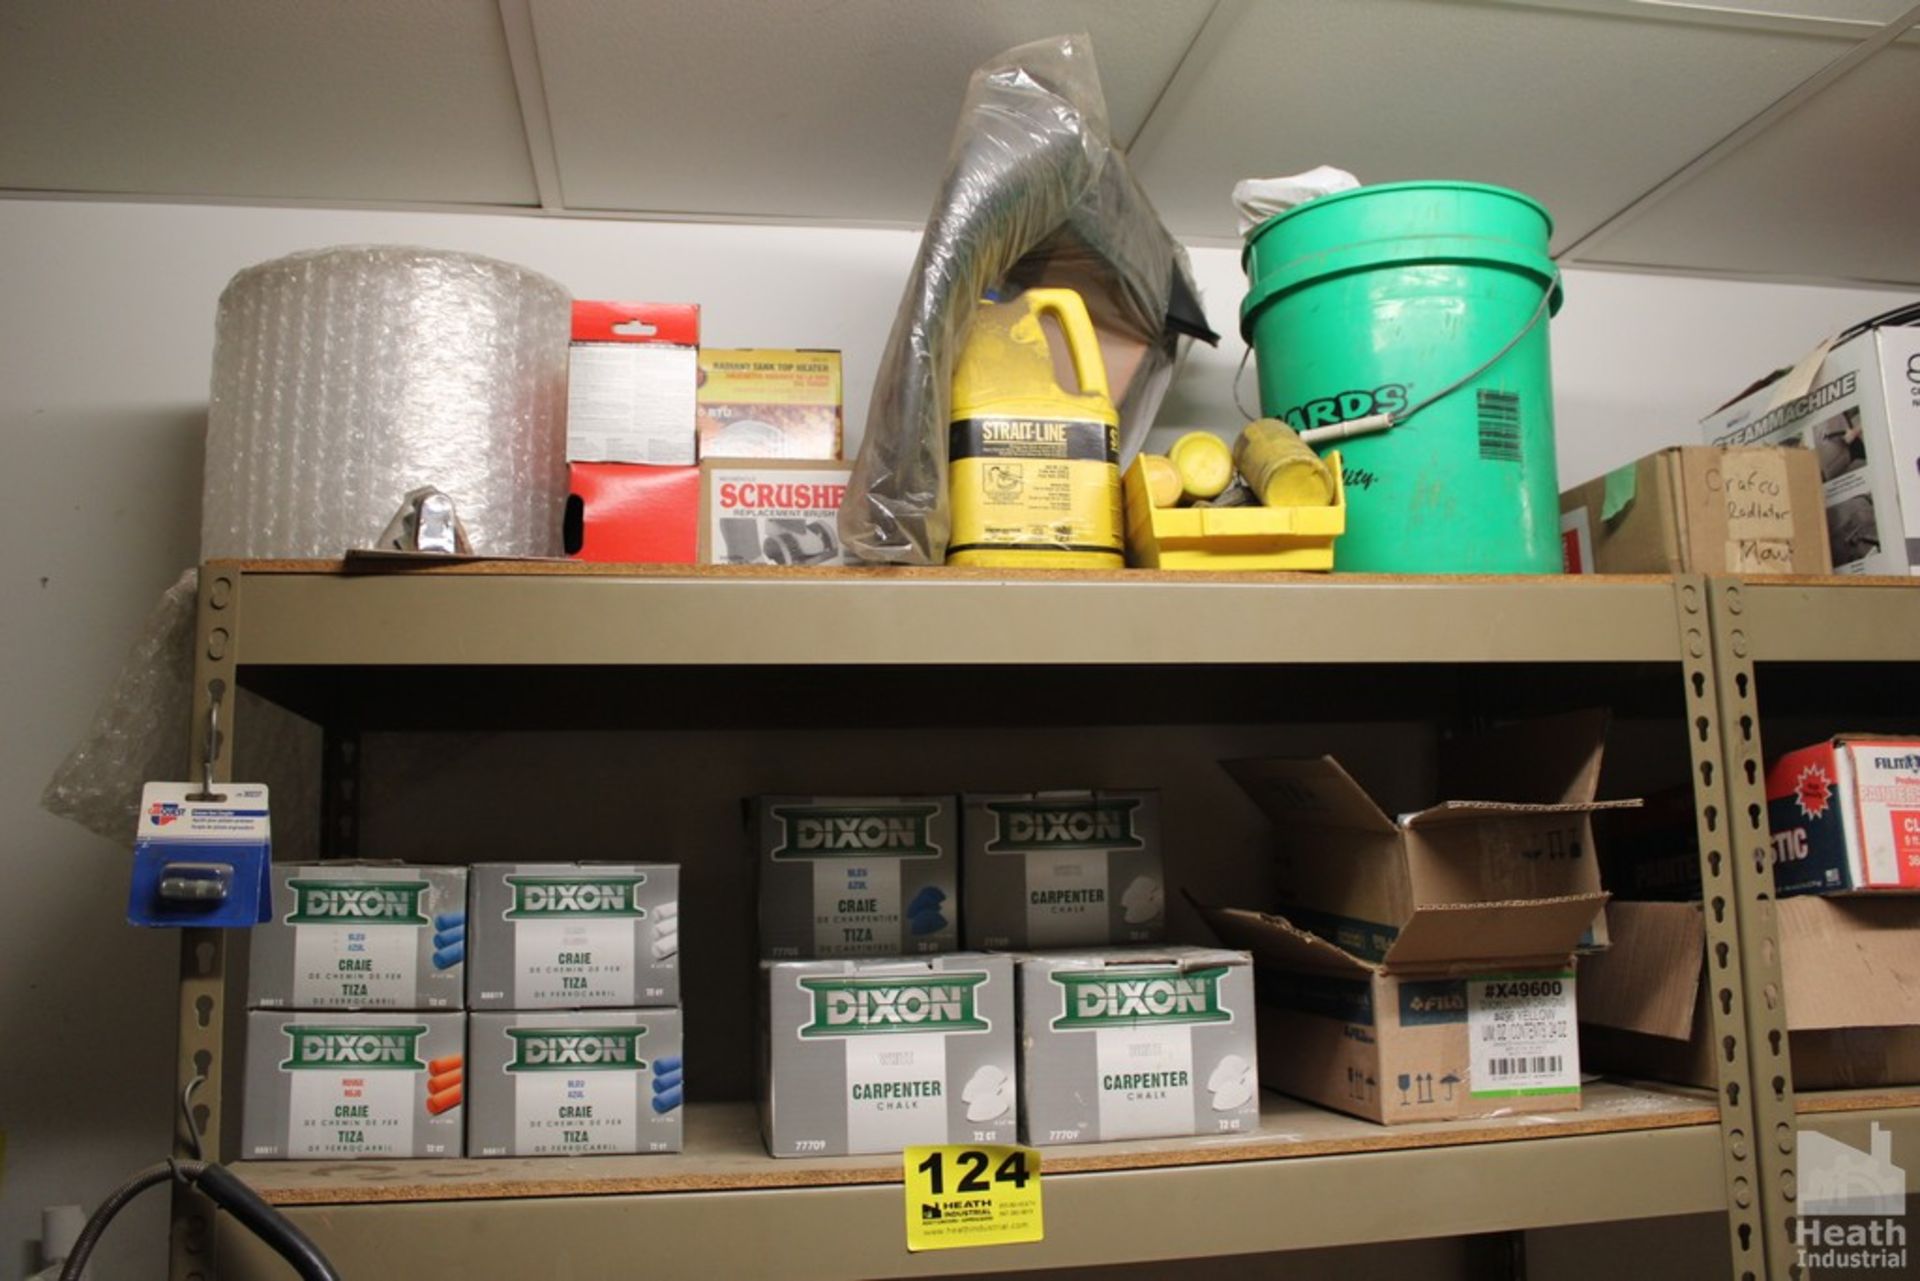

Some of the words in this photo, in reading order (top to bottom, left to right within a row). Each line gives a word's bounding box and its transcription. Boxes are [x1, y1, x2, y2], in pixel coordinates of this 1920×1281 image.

[982, 421, 1067, 441] STRAIT-LINE
[798, 817, 915, 848] DIXON
[1009, 812, 1121, 842] DIXON
[306, 890, 408, 916] DIXON
[525, 885, 625, 911] DIXON
[1030, 889, 1105, 905] CARPENTER
[838, 900, 877, 913] CRAIE
[843, 928, 873, 942] TIZA
[338, 959, 373, 971] CRAIE
[558, 953, 591, 964] CRAIE
[342, 984, 368, 996] TIZA
[562, 977, 588, 989] TIZA
[1484, 981, 1562, 998] #X49600
[827, 985, 962, 1024] DIXON
[1078, 978, 1206, 1017] DIXON
[302, 1035, 406, 1062] DIXON
[525, 1037, 627, 1063] DIXON
[1103, 1071, 1188, 1090] CARPENTER
[852, 1080, 942, 1100] CARPENTER
[1127, 1091, 1167, 1101] CHALK
[334, 1105, 369, 1117] CRAIE
[559, 1106, 593, 1118] CRAIE
[877, 1101, 918, 1111] CHALK
[338, 1130, 364, 1143] TIZA
[562, 1130, 589, 1143] TIZA
[795, 1140, 826, 1150] 77709
[918, 1151, 1030, 1195] 124
[943, 1200, 992, 1209] HEATH
[944, 1209, 991, 1218] INDUSTRIAL
